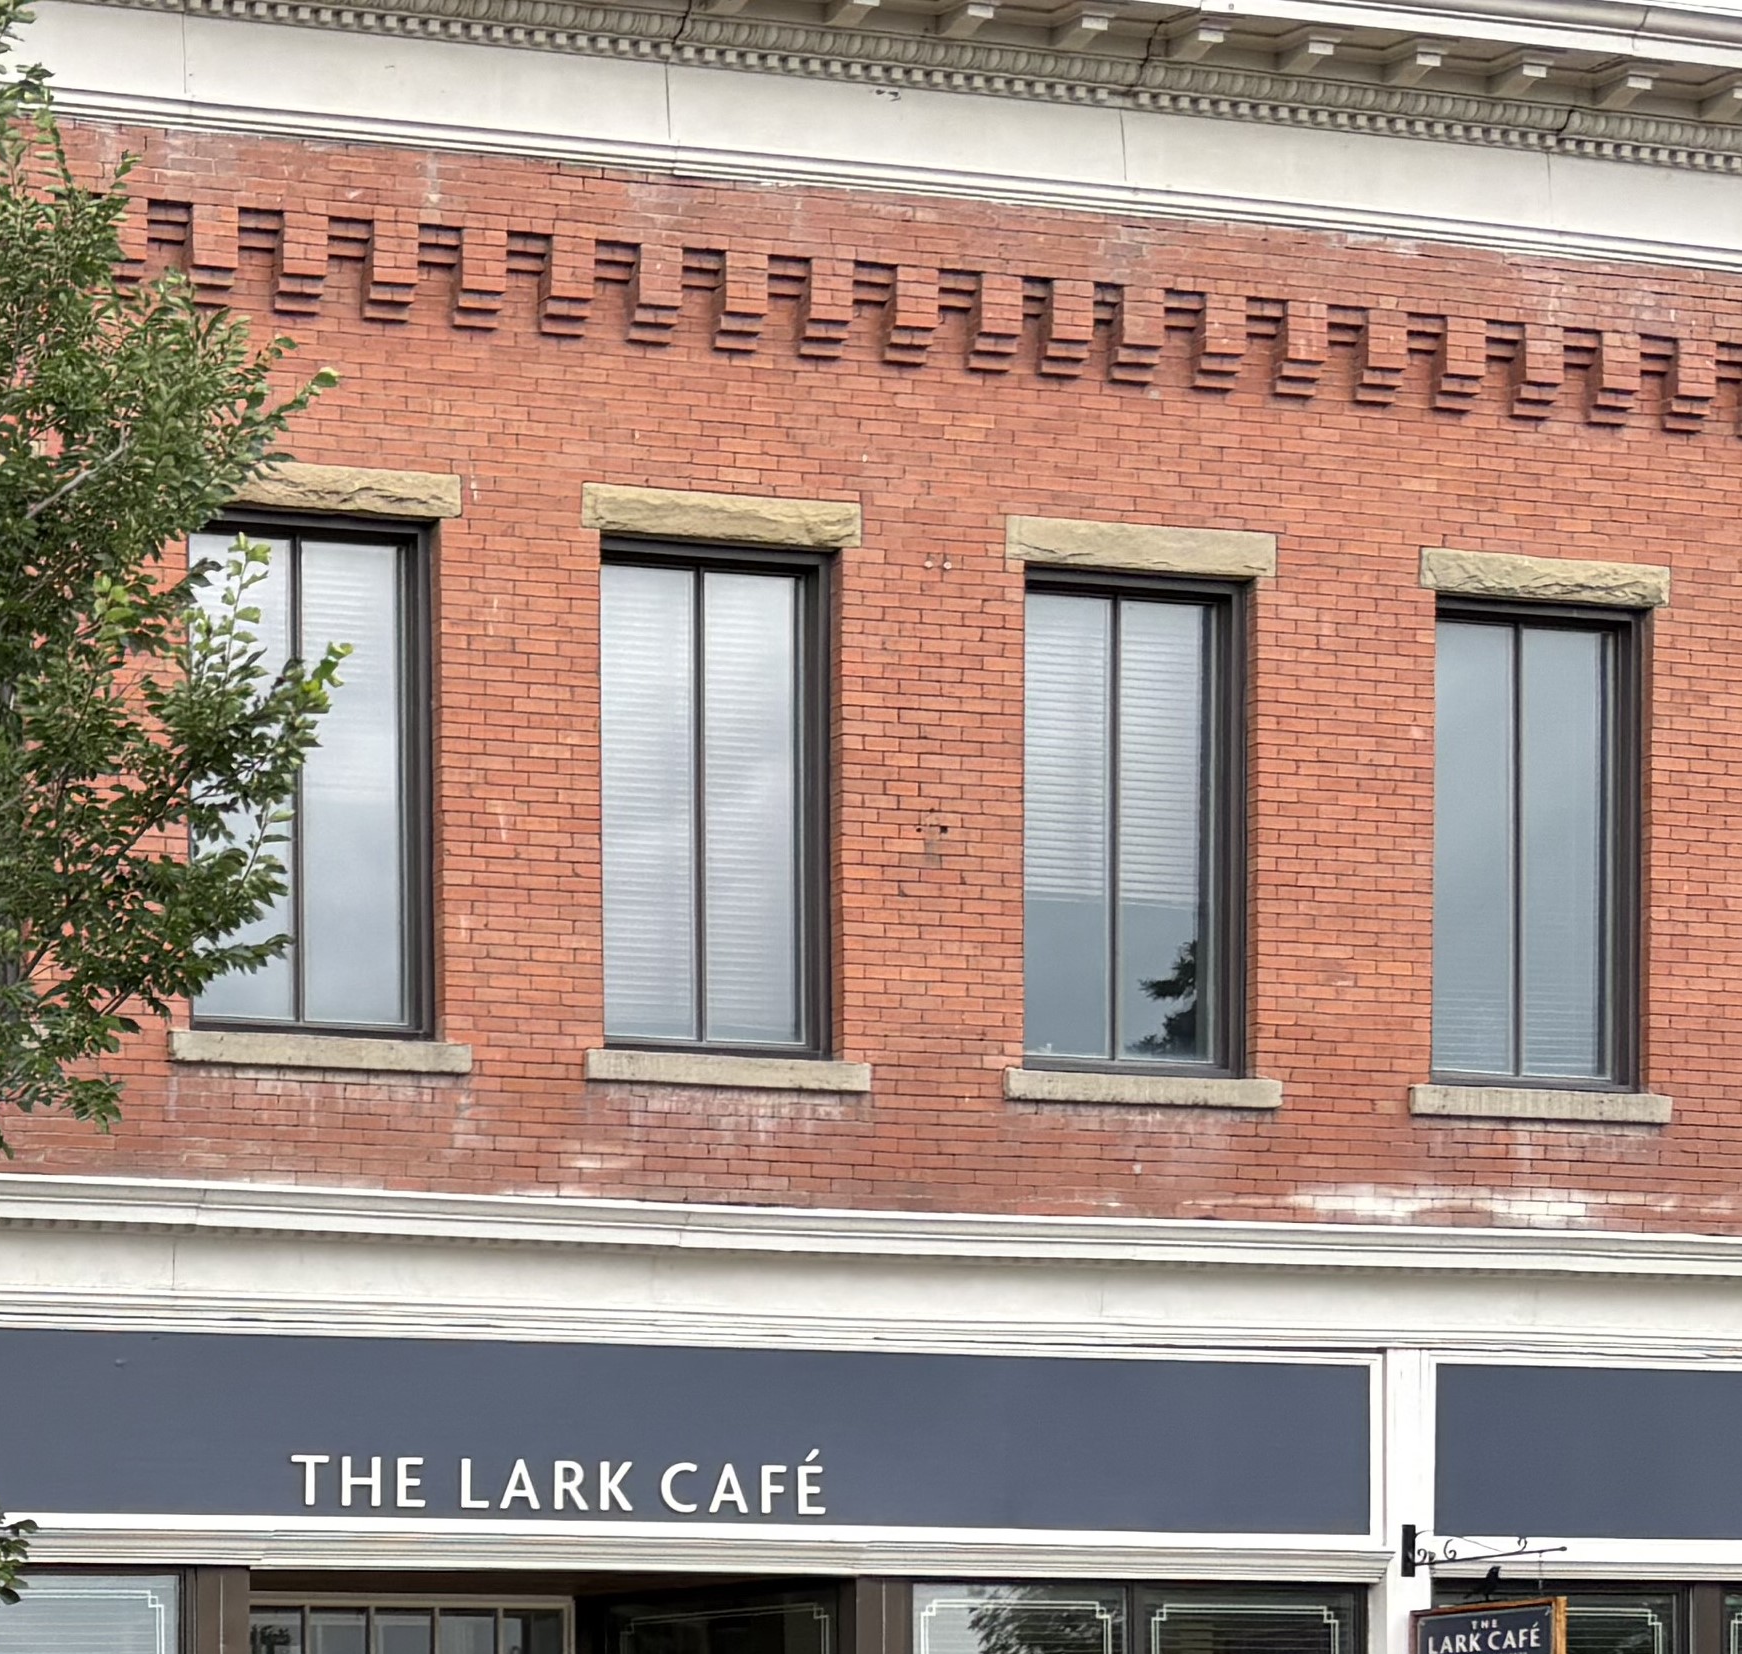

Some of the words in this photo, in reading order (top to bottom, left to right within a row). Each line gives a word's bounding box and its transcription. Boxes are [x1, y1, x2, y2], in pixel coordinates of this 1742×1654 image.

[290, 1453, 427, 1509] THE
[458, 1457, 634, 1512] LARK
[659, 1448, 828, 1516] CAFÉ
[1471, 1618, 1498, 1630] THE
[1487, 1621, 1542, 1651] CAFÉ
